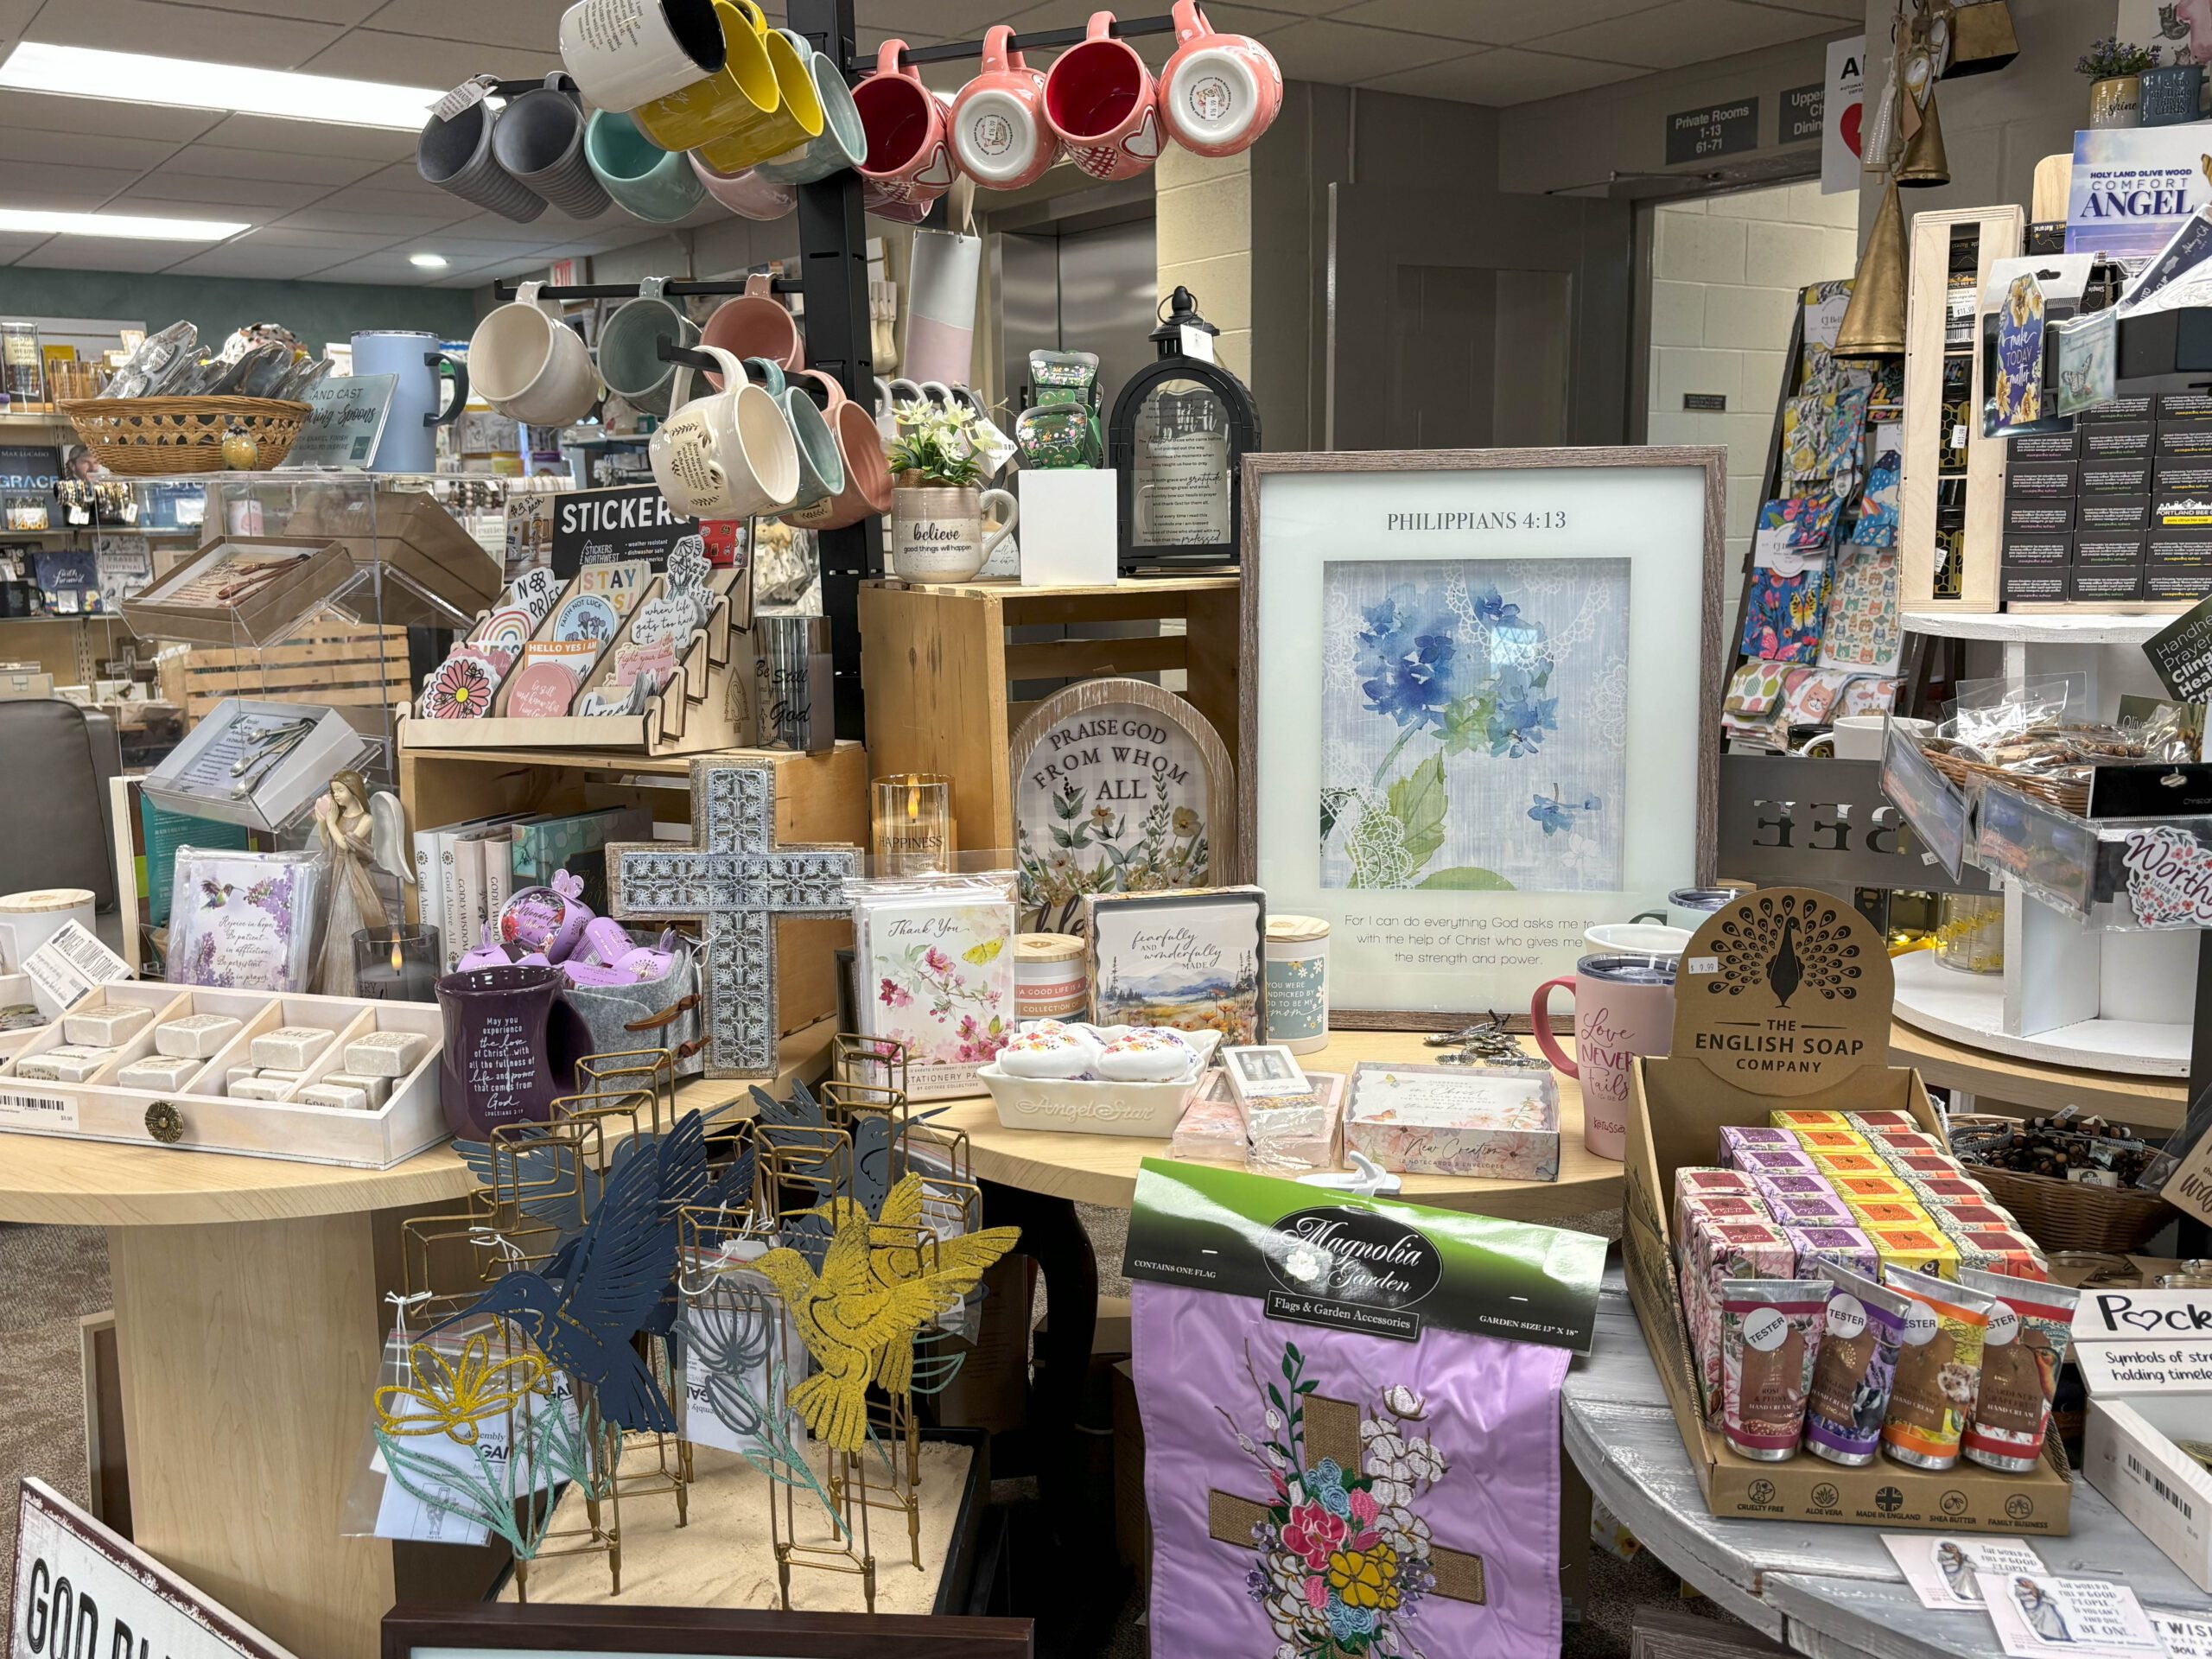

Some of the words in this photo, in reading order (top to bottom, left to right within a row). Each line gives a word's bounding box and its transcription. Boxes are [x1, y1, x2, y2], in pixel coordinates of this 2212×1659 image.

[1675, 112, 1709, 130] Private
[1712, 105, 1749, 123] Rooms
[1700, 124, 1721, 138] 1-13
[1695, 139, 1723, 154] 61-71
[2091, 177, 2189, 191] COMFORT
[2080, 189, 2194, 218] ANGEL
[2006, 346, 2032, 366] TODAY
[337, 388, 364, 399] CAST
[338, 404, 376, 427] Spoons
[562, 496, 690, 535] STICKER
[1387, 512, 1516, 531] PHILIPPIANS
[1522, 511, 1567, 529] 4:13
[914, 522, 960, 542] believe
[585, 543, 613, 555] STICKERS
[919, 544, 939, 554] things
[584, 553, 620, 564] NORTHWEST
[582, 568, 637, 591] STAY
[561, 608, 573, 627] FAITH
[586, 598, 603, 610] LUCK
[645, 603, 674, 615] when
[529, 643, 563, 652] HELLO
[564, 642, 582, 652] YES
[2164, 633, 2211, 671] Prayer
[756, 660, 770, 677] Be
[772, 669, 808, 683] Still
[770, 700, 811, 729] God
[1048, 720, 1118, 751] PRAISE
[1123, 721, 1166, 745] GOD
[1033, 747, 1102, 790] FROM
[1111, 747, 1189, 785] WHOM
[1096, 779, 1147, 800] ALL
[879, 835, 942, 849] HAPPINESS
[458, 878, 467, 910] GODLY
[491, 876, 499, 909] GODLY
[219, 915, 245, 929] Rejoice
[888, 918, 931, 938] Thank
[933, 918, 969, 938] You
[1344, 915, 1364, 927] For
[1376, 917, 1399, 926] can
[1403, 916, 1420, 927] do
[1425, 916, 1486, 930] everything
[1491, 917, 1518, 928] God
[1523, 918, 1554, 929] asks
[1559, 920, 1578, 929] me
[1132, 927, 1199, 950] fearfully
[1357, 933, 1380, 944] with
[1386, 934, 1404, 944] the
[1409, 934, 1433, 946] help
[1439, 935, 1452, 945] of
[1455, 935, 1491, 946] Christ
[1495, 936, 1522, 947] who
[1527, 938, 1558, 949] gives
[1563, 938, 1583, 947] me
[1143, 943, 1221, 967] wonderfully
[1395, 952, 1413, 963] the
[1418, 952, 1467, 965] strength
[1472, 953, 1496, 963] and
[1501, 955, 1542, 966] power.
[1700, 963, 1715, 972] 9.99
[1055, 986, 1069, 995] LIFE
[1023, 1003, 1071, 1013] COLLECTION
[486, 1018, 501, 1027] May
[505, 1017, 518, 1027] you
[1581, 1007, 1636, 1048] Love
[1767, 1020, 1796, 1032] THE
[483, 1026, 523, 1036] experience
[480, 1037, 499, 1048] the
[499, 1033, 527, 1048] love
[1695, 1033, 1794, 1053] ENGLISH
[1803, 1038, 1864, 1056] SOAP
[481, 1059, 493, 1069] the
[496, 1058, 526, 1069] fullness
[1736, 1058, 1821, 1073] COMPANY
[906, 1073, 962, 1084] STATIONERY
[1582, 1065, 1629, 1101] Fails
[474, 1084, 489, 1092] that
[487, 1092, 520, 1109] God
[1404, 1138, 1438, 1156] New
[1442, 1138, 1502, 1160] Creation
[1281, 1216, 1424, 1268] Magnolia
[1135, 1260, 1175, 1273] CONTAINS
[1176, 1266, 1192, 1275] ONE
[1193, 1268, 1217, 1279] FLAG
[1327, 1257, 1413, 1294] Garden
[1274, 1298, 1300, 1312] Flags
[1314, 1304, 1351, 1319] Garden
[1353, 1310, 1411, 1330] Accessories
[1829, 1308, 1864, 1325] TESTER
[1479, 1315, 1519, 1327] GARDEN
[1521, 1322, 1541, 1332] SIZE
[1749, 1316, 1785, 1344] TESTER
[2106, 1351, 2165, 1367] Symbols
[2170, 1351, 2183, 1363] of
[2112, 1369, 2165, 1383] holding
[1828, 1396, 1849, 1410] CREAM
[1893, 1395, 1912, 1406] HAND
[1913, 1402, 1935, 1414] CREAM
[1987, 1404, 2008, 1413] HAND
[2009, 1408, 2034, 1418] CREAM
[1886, 1512, 1921, 1521] ENGLAND
[1988, 1518, 2012, 1527] FAMILY
[2014, 1520, 2048, 1529] BUSINESS
[2080, 1624, 2099, 1635] BE
